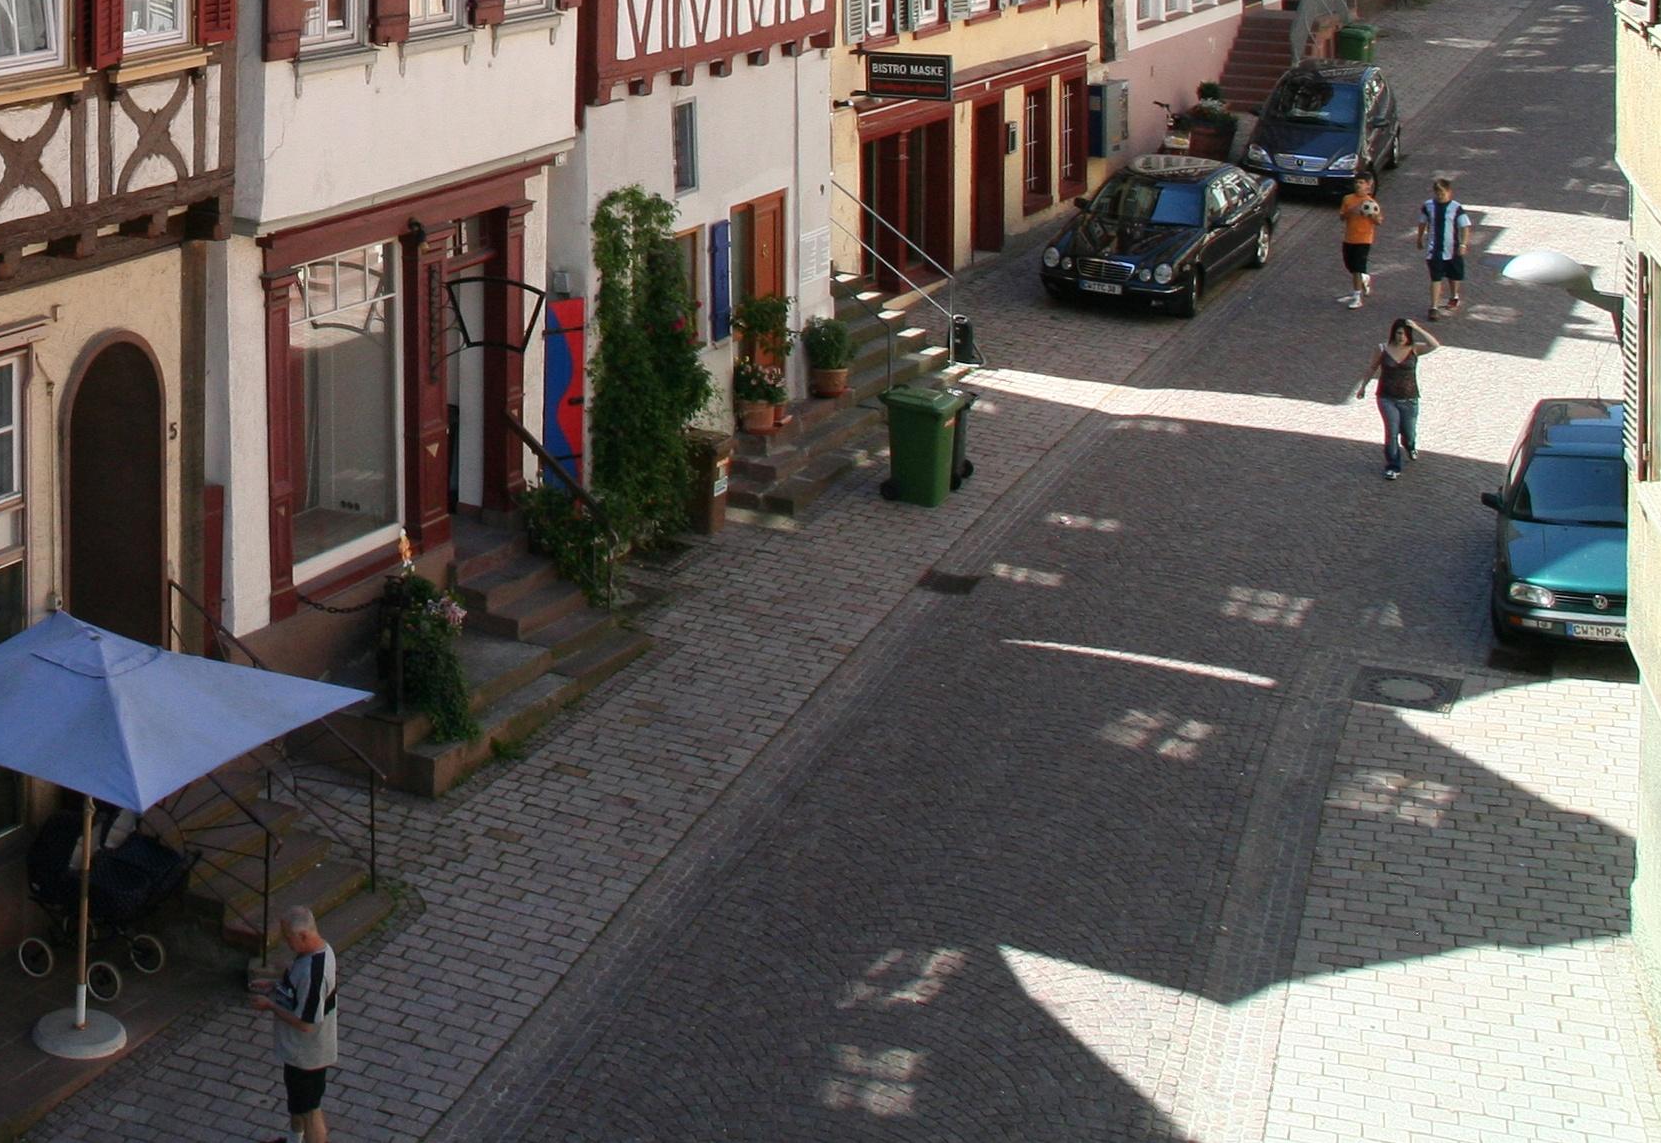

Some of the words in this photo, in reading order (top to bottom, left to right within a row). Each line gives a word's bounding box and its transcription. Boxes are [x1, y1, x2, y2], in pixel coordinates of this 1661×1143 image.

[871, 63, 907, 75] BISTRO
[910, 64, 944, 77] MASKE
[169, 422, 178, 440] 5
